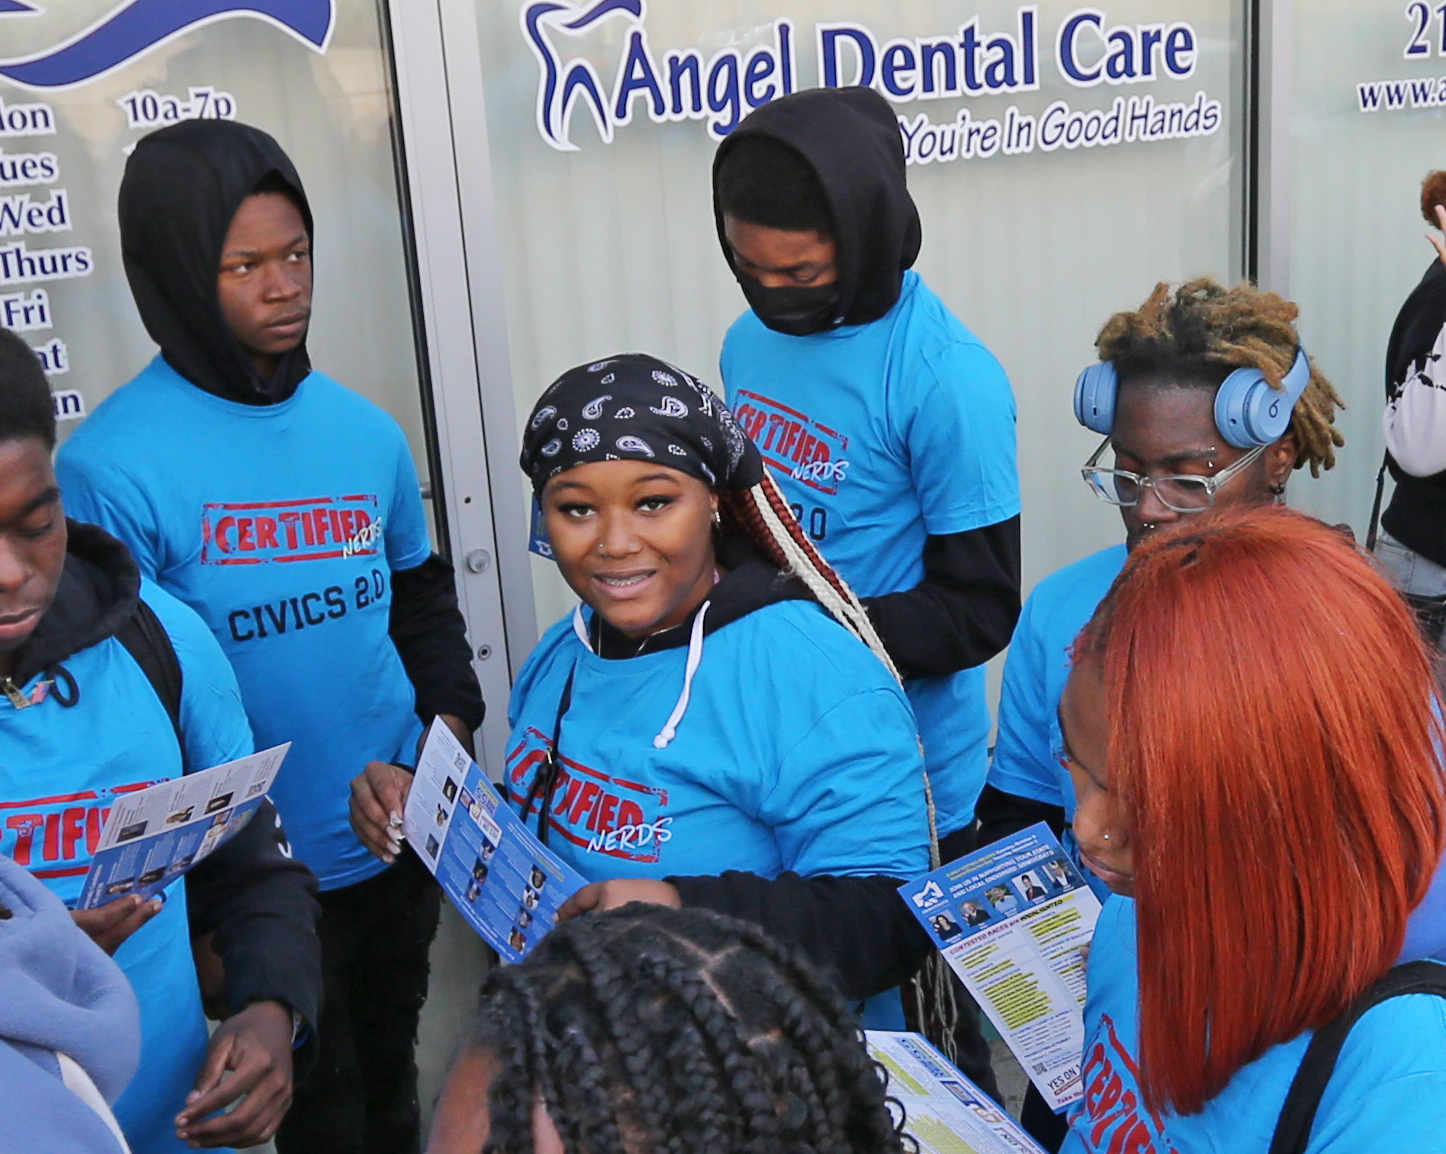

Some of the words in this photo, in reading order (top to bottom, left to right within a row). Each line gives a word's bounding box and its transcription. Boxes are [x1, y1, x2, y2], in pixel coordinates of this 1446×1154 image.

[615, 21, 793, 136] Angel
[821, 10, 1036, 98] Dental
[1059, 10, 1196, 82] Care
[124, 91, 233, 122] 10a-7p
[1004, 111, 1034, 150] In
[1041, 102, 1120, 146] Good
[1126, 96, 1220, 140] Hands
[3, 293, 49, 328] Fri
[36, 343, 65, 371] at
[789, 459, 851, 482] NERDS
[214, 507, 373, 555] CERTIFIED
[342, 515, 384, 560] NERDS
[227, 585, 348, 643] CIVICS
[586, 817, 674, 855] NERDS
